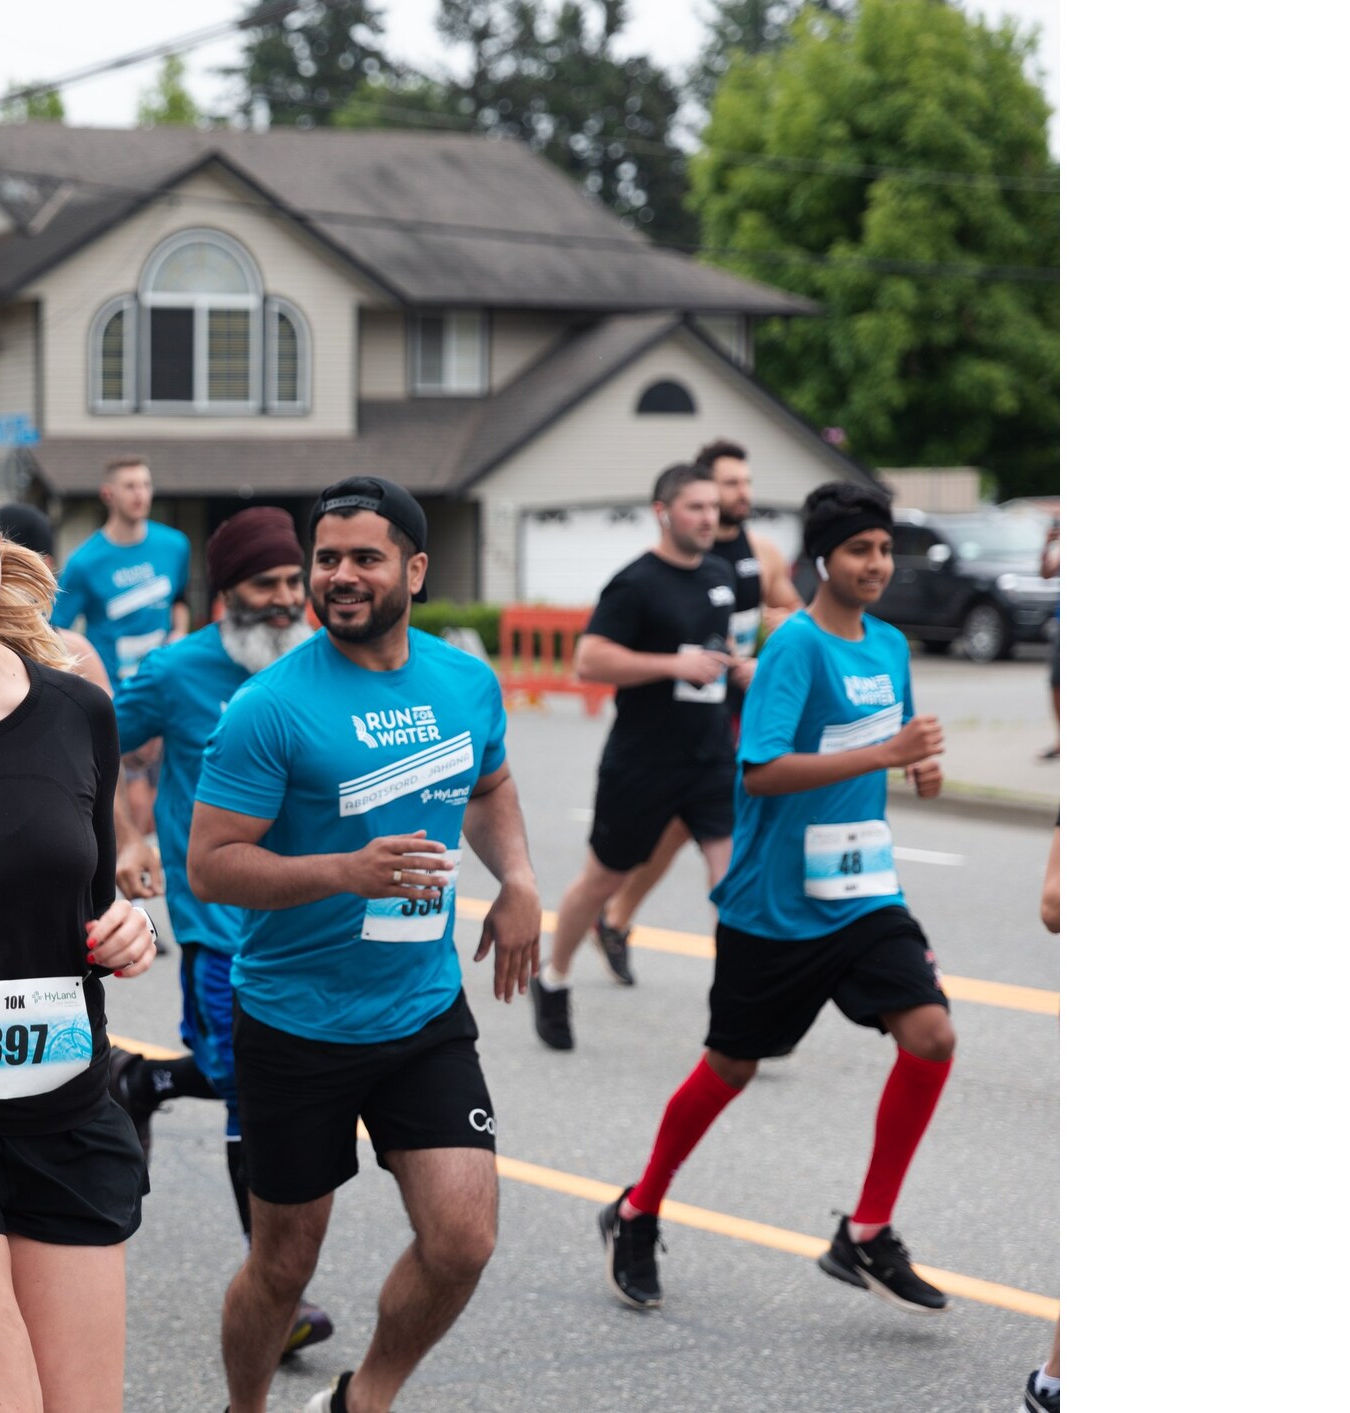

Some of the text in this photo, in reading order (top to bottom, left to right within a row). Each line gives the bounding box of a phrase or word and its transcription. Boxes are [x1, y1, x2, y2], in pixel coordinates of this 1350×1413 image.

[365, 708, 435, 731] RUN FOR
[376, 725, 441, 746] WATER
[345, 752, 470, 810] ABBOTSFORD JAHANA
[840, 851, 862, 874] 48
[4, 995, 25, 1009] 10K
[44, 990, 77, 1003] HyLand
